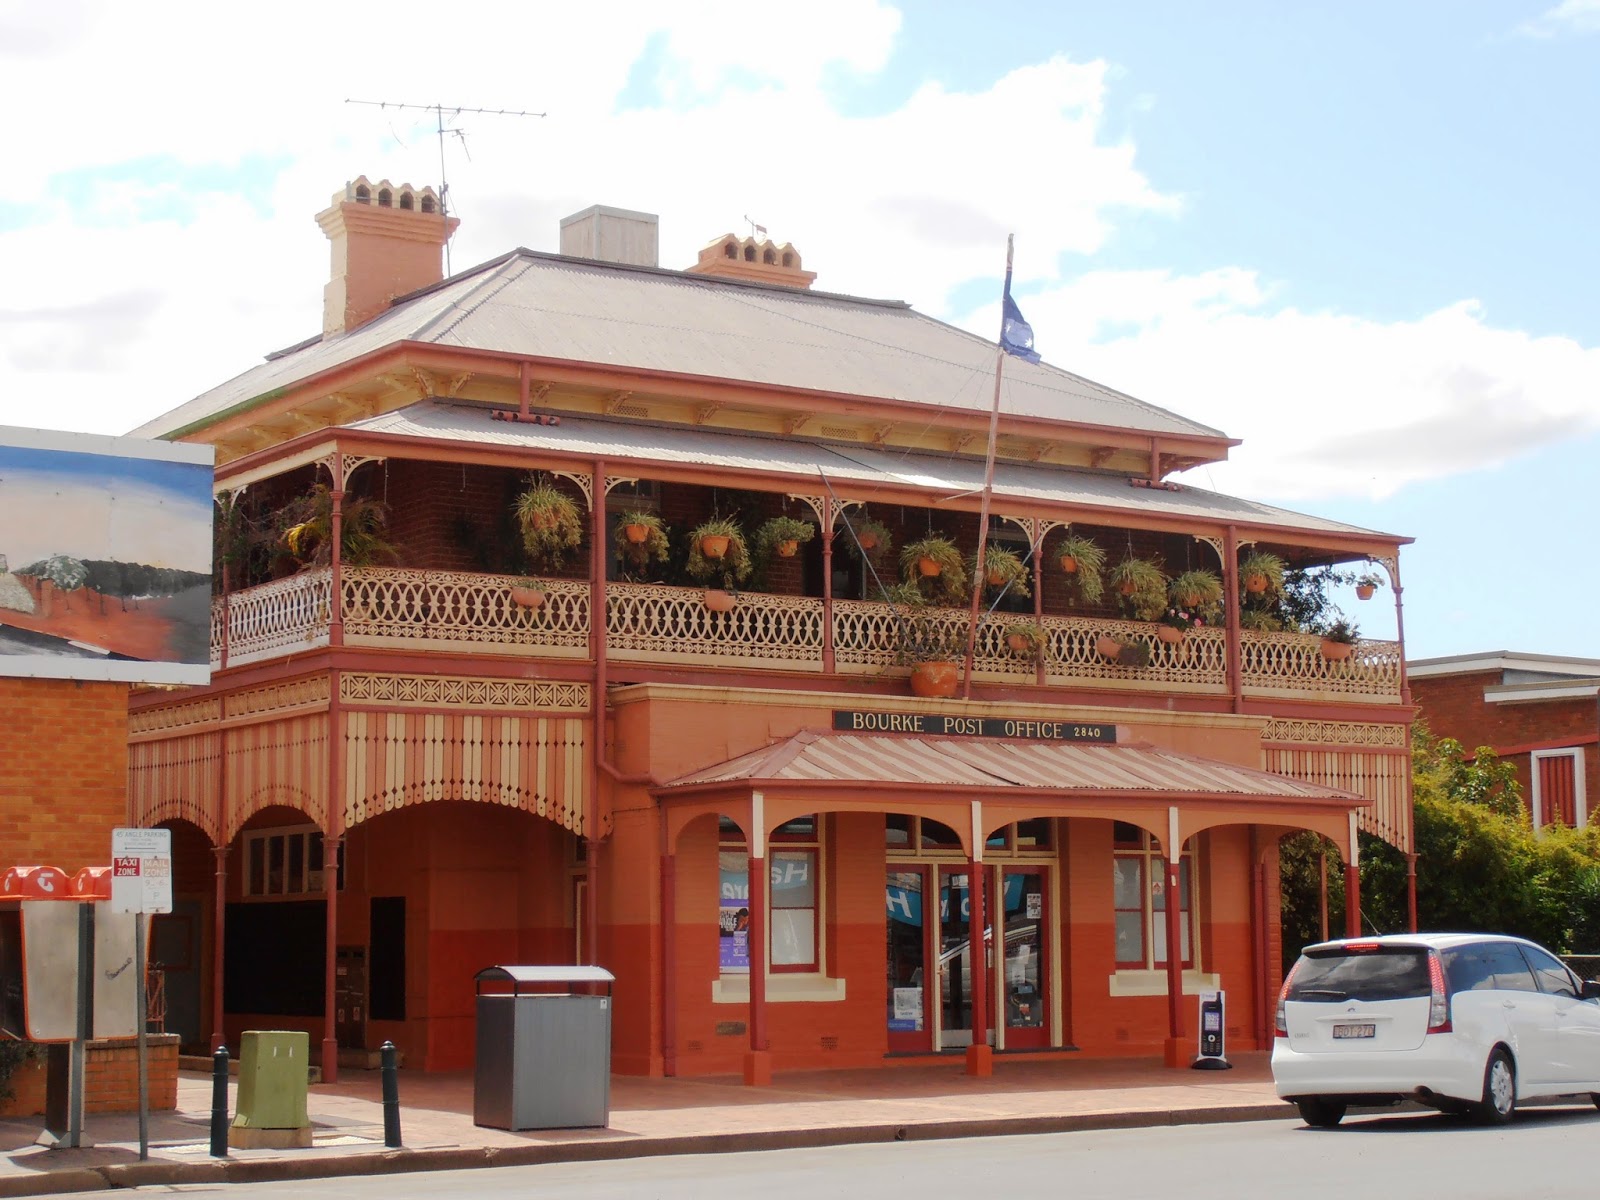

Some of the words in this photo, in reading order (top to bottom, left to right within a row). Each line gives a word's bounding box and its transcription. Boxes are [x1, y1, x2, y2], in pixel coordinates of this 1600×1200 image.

[852, 712, 925, 732] BOURKE
[943, 717, 985, 735] POST
[1004, 720, 1064, 739] OFFICE
[1073, 726, 1101, 738] 2840
[116, 858, 138, 866] TAXI
[116, 867, 137, 876] ZONE
[144, 868, 169, 877] ZONE
